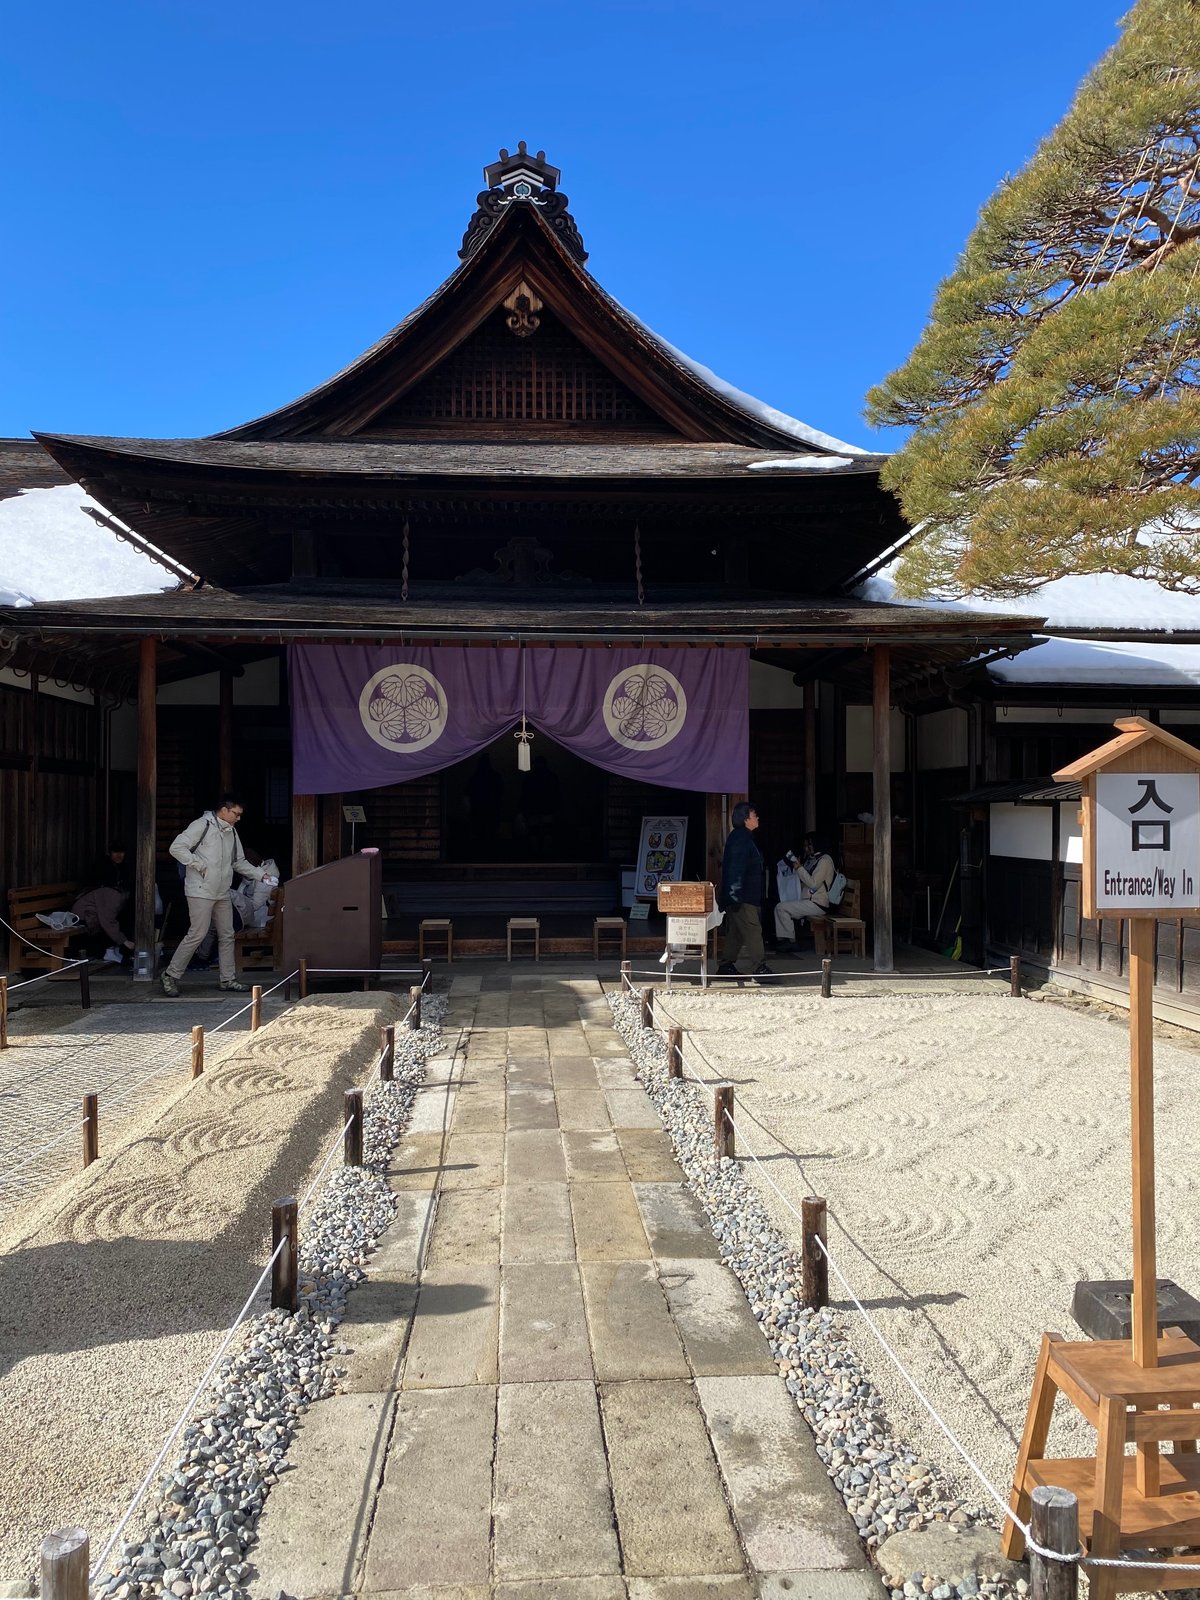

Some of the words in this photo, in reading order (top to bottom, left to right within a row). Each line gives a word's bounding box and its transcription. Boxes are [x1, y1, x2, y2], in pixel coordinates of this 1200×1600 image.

[1128, 779, 1174, 851] 入口
[1104, 866, 1176, 899] Entrance/Way
[1182, 868, 1193, 895] In
